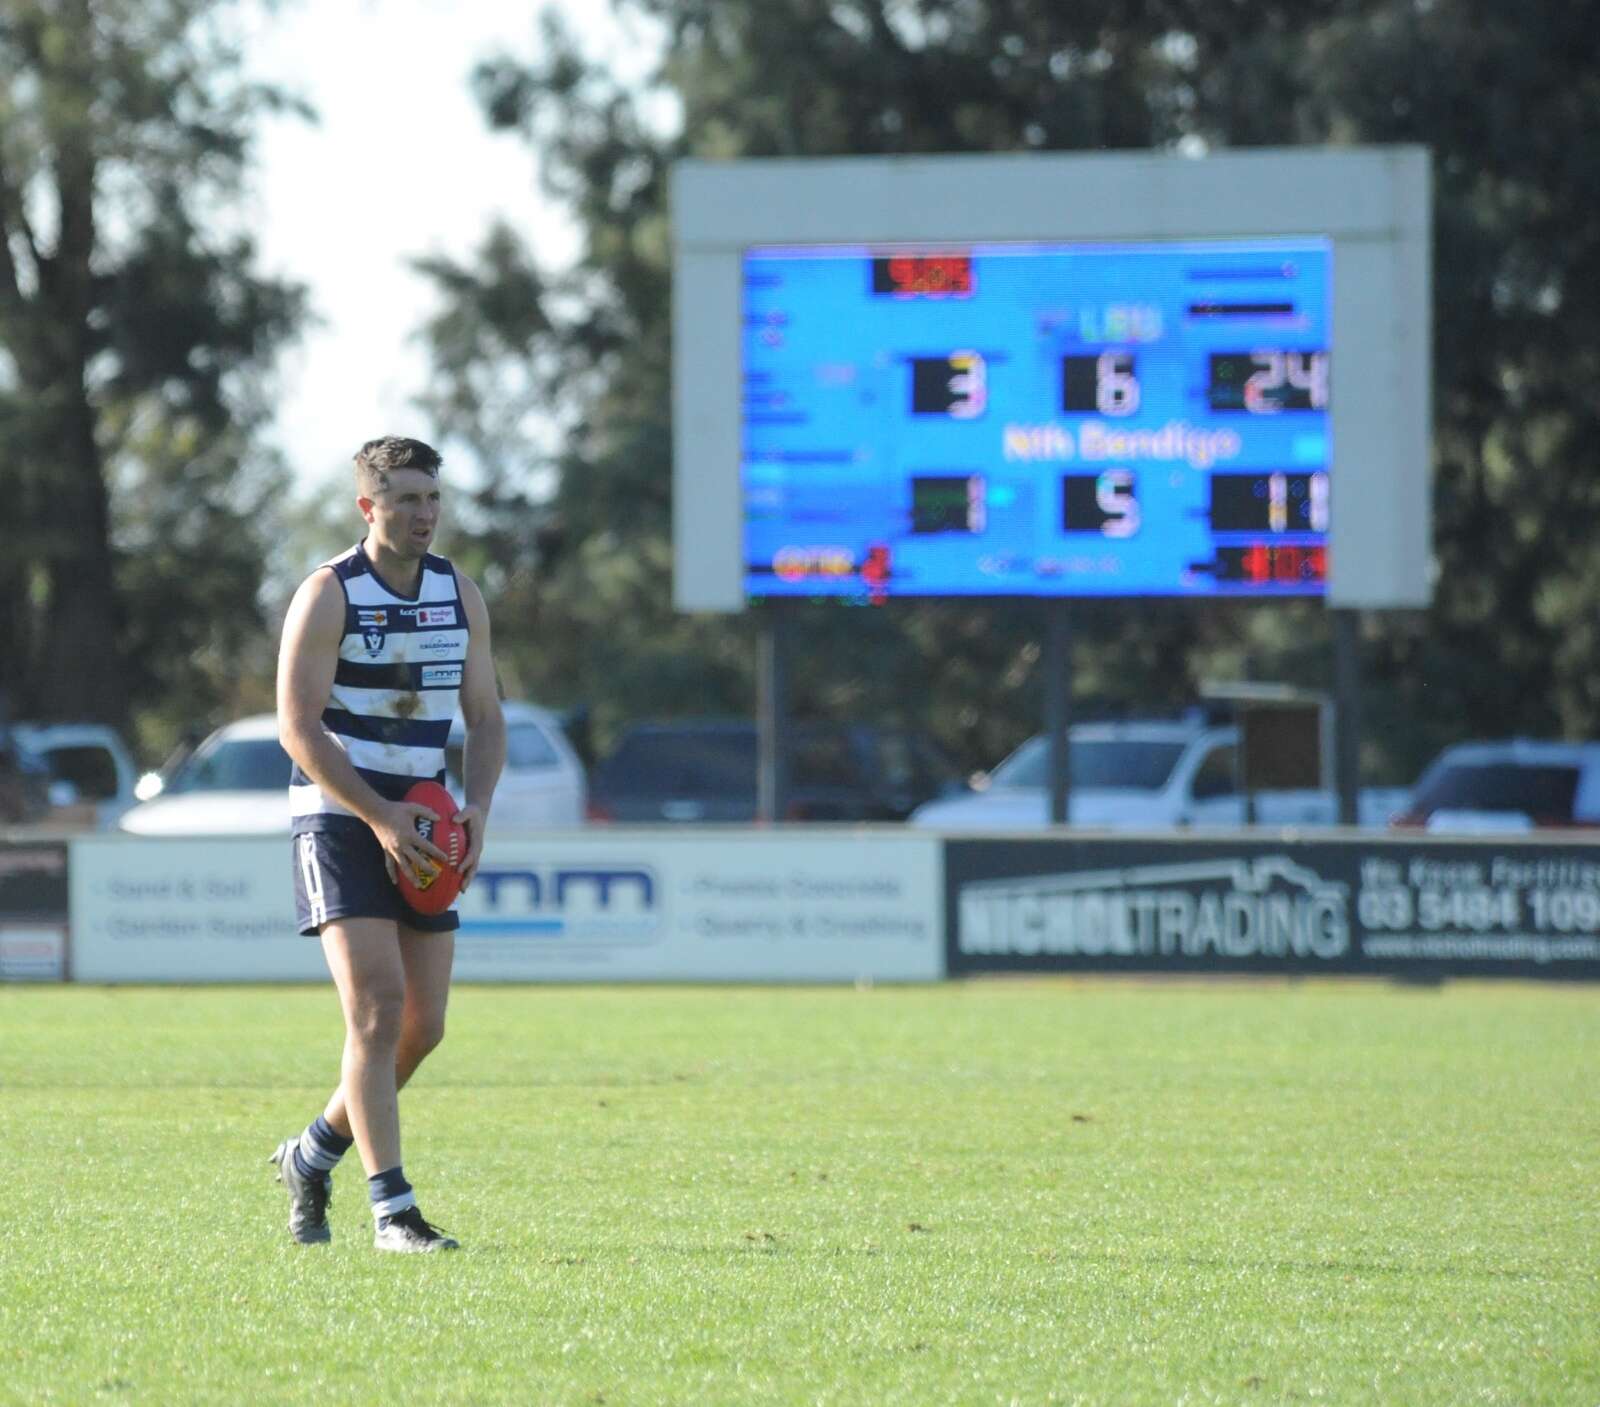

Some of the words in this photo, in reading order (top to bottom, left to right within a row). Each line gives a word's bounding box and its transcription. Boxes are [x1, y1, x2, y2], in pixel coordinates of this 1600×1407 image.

[947, 350, 986, 418] 3
[1097, 350, 1141, 416] 6
[1243, 350, 1329, 414] 24
[1080, 420, 1242, 469] Bendigo
[967, 472, 986, 533] 1
[1096, 470, 1141, 538] 5
[1269, 472, 1329, 533] 11
